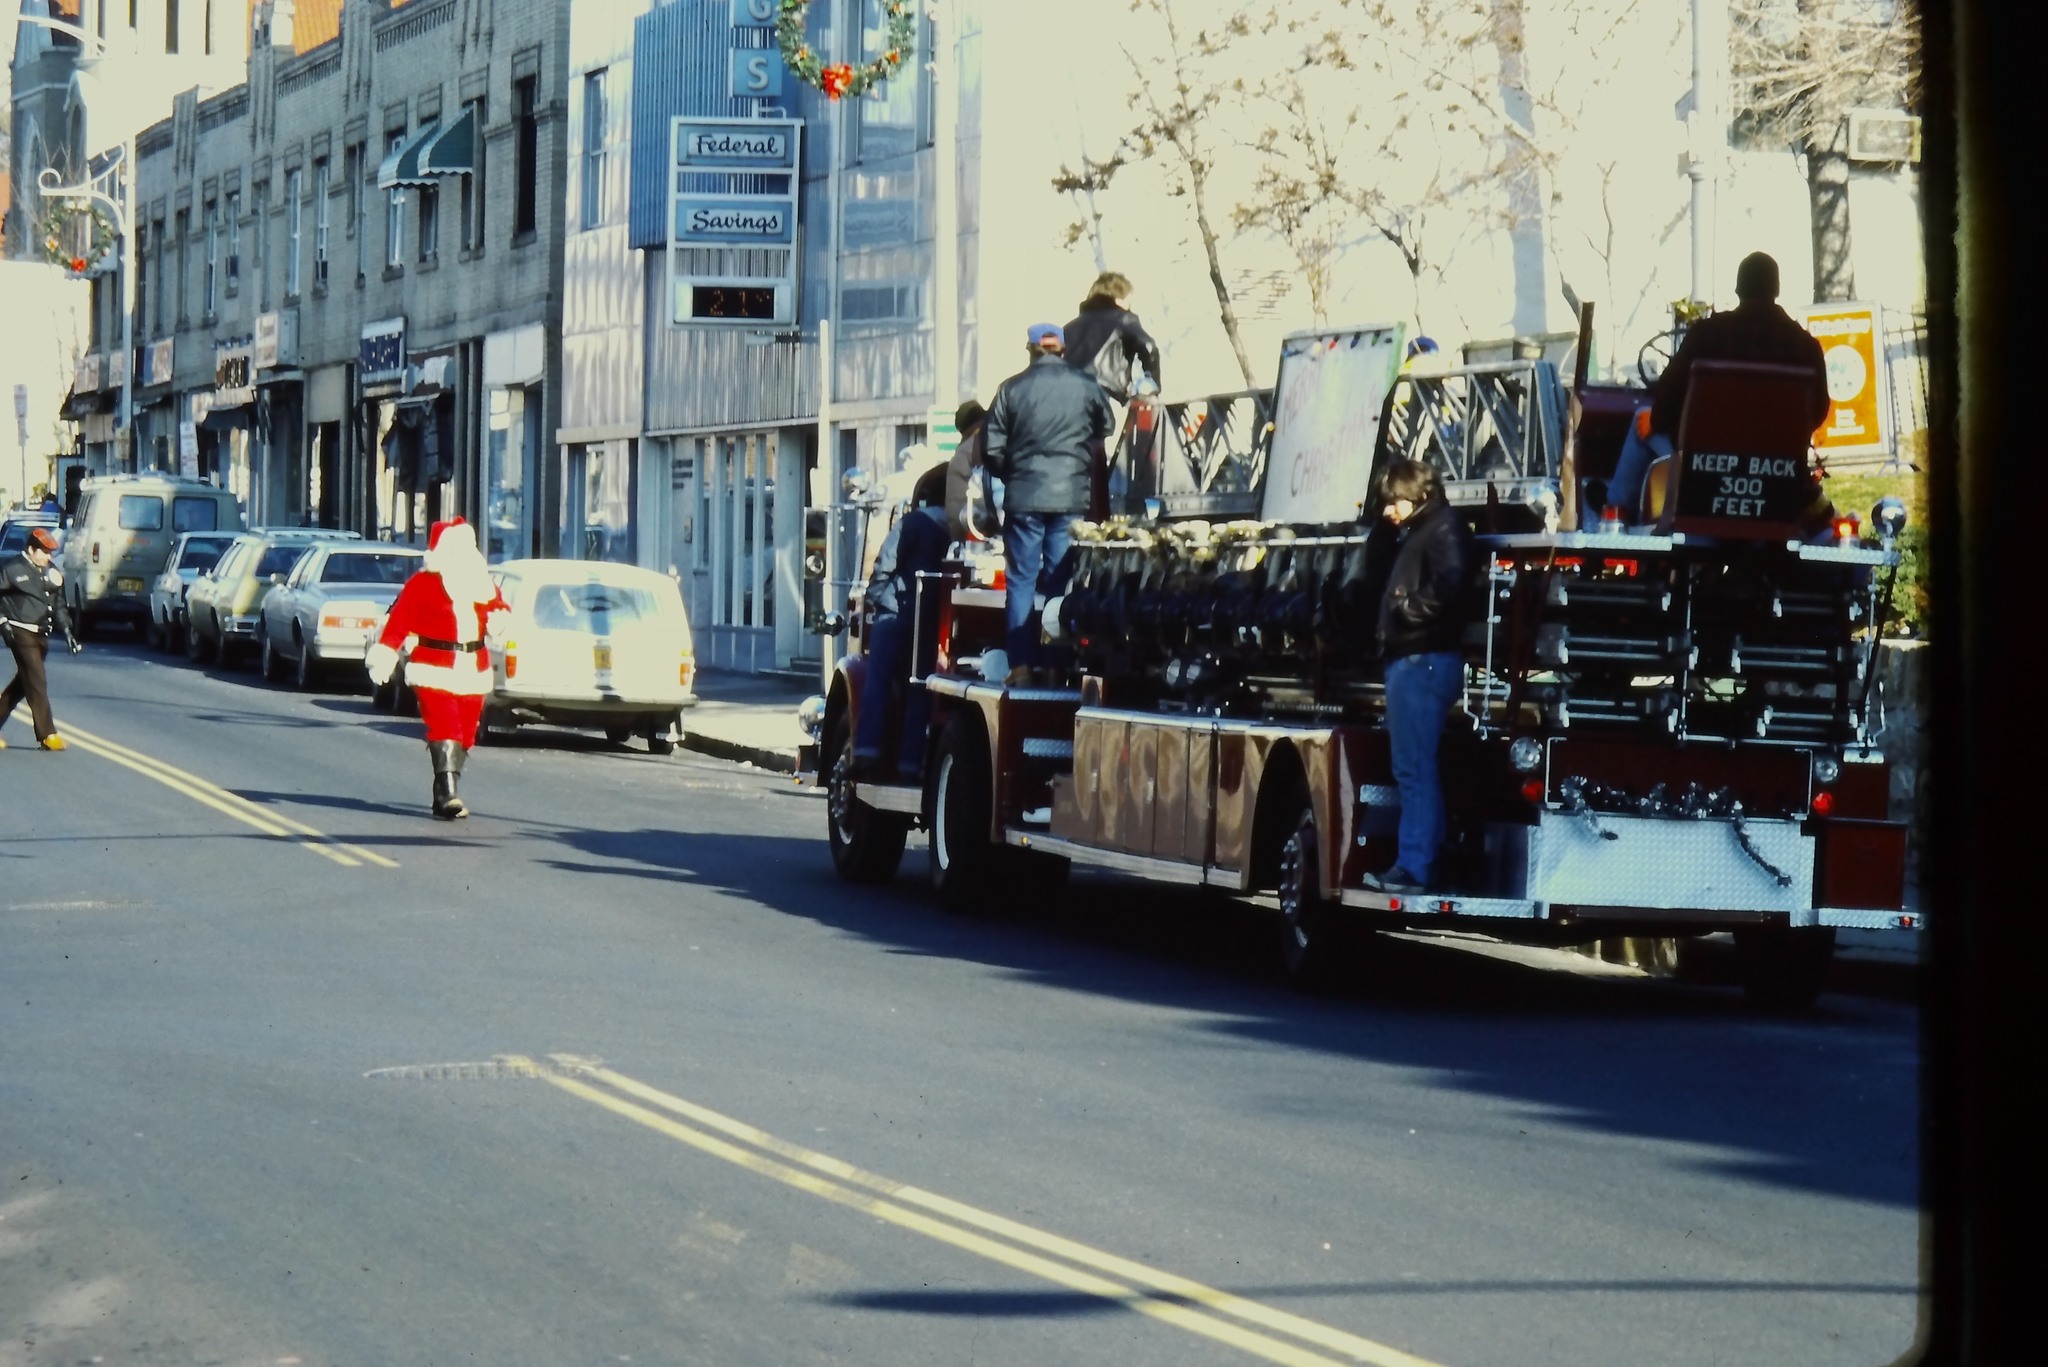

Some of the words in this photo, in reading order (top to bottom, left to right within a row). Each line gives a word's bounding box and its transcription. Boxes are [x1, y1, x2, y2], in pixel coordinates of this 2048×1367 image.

[696, 135, 778, 154] Federal
[692, 209, 778, 233] Savings
[1692, 453, 1739, 473] KEEP
[1749, 457, 1796, 477] BACK
[1720, 476, 1763, 495] 300
[1712, 497, 1766, 516] FEET
